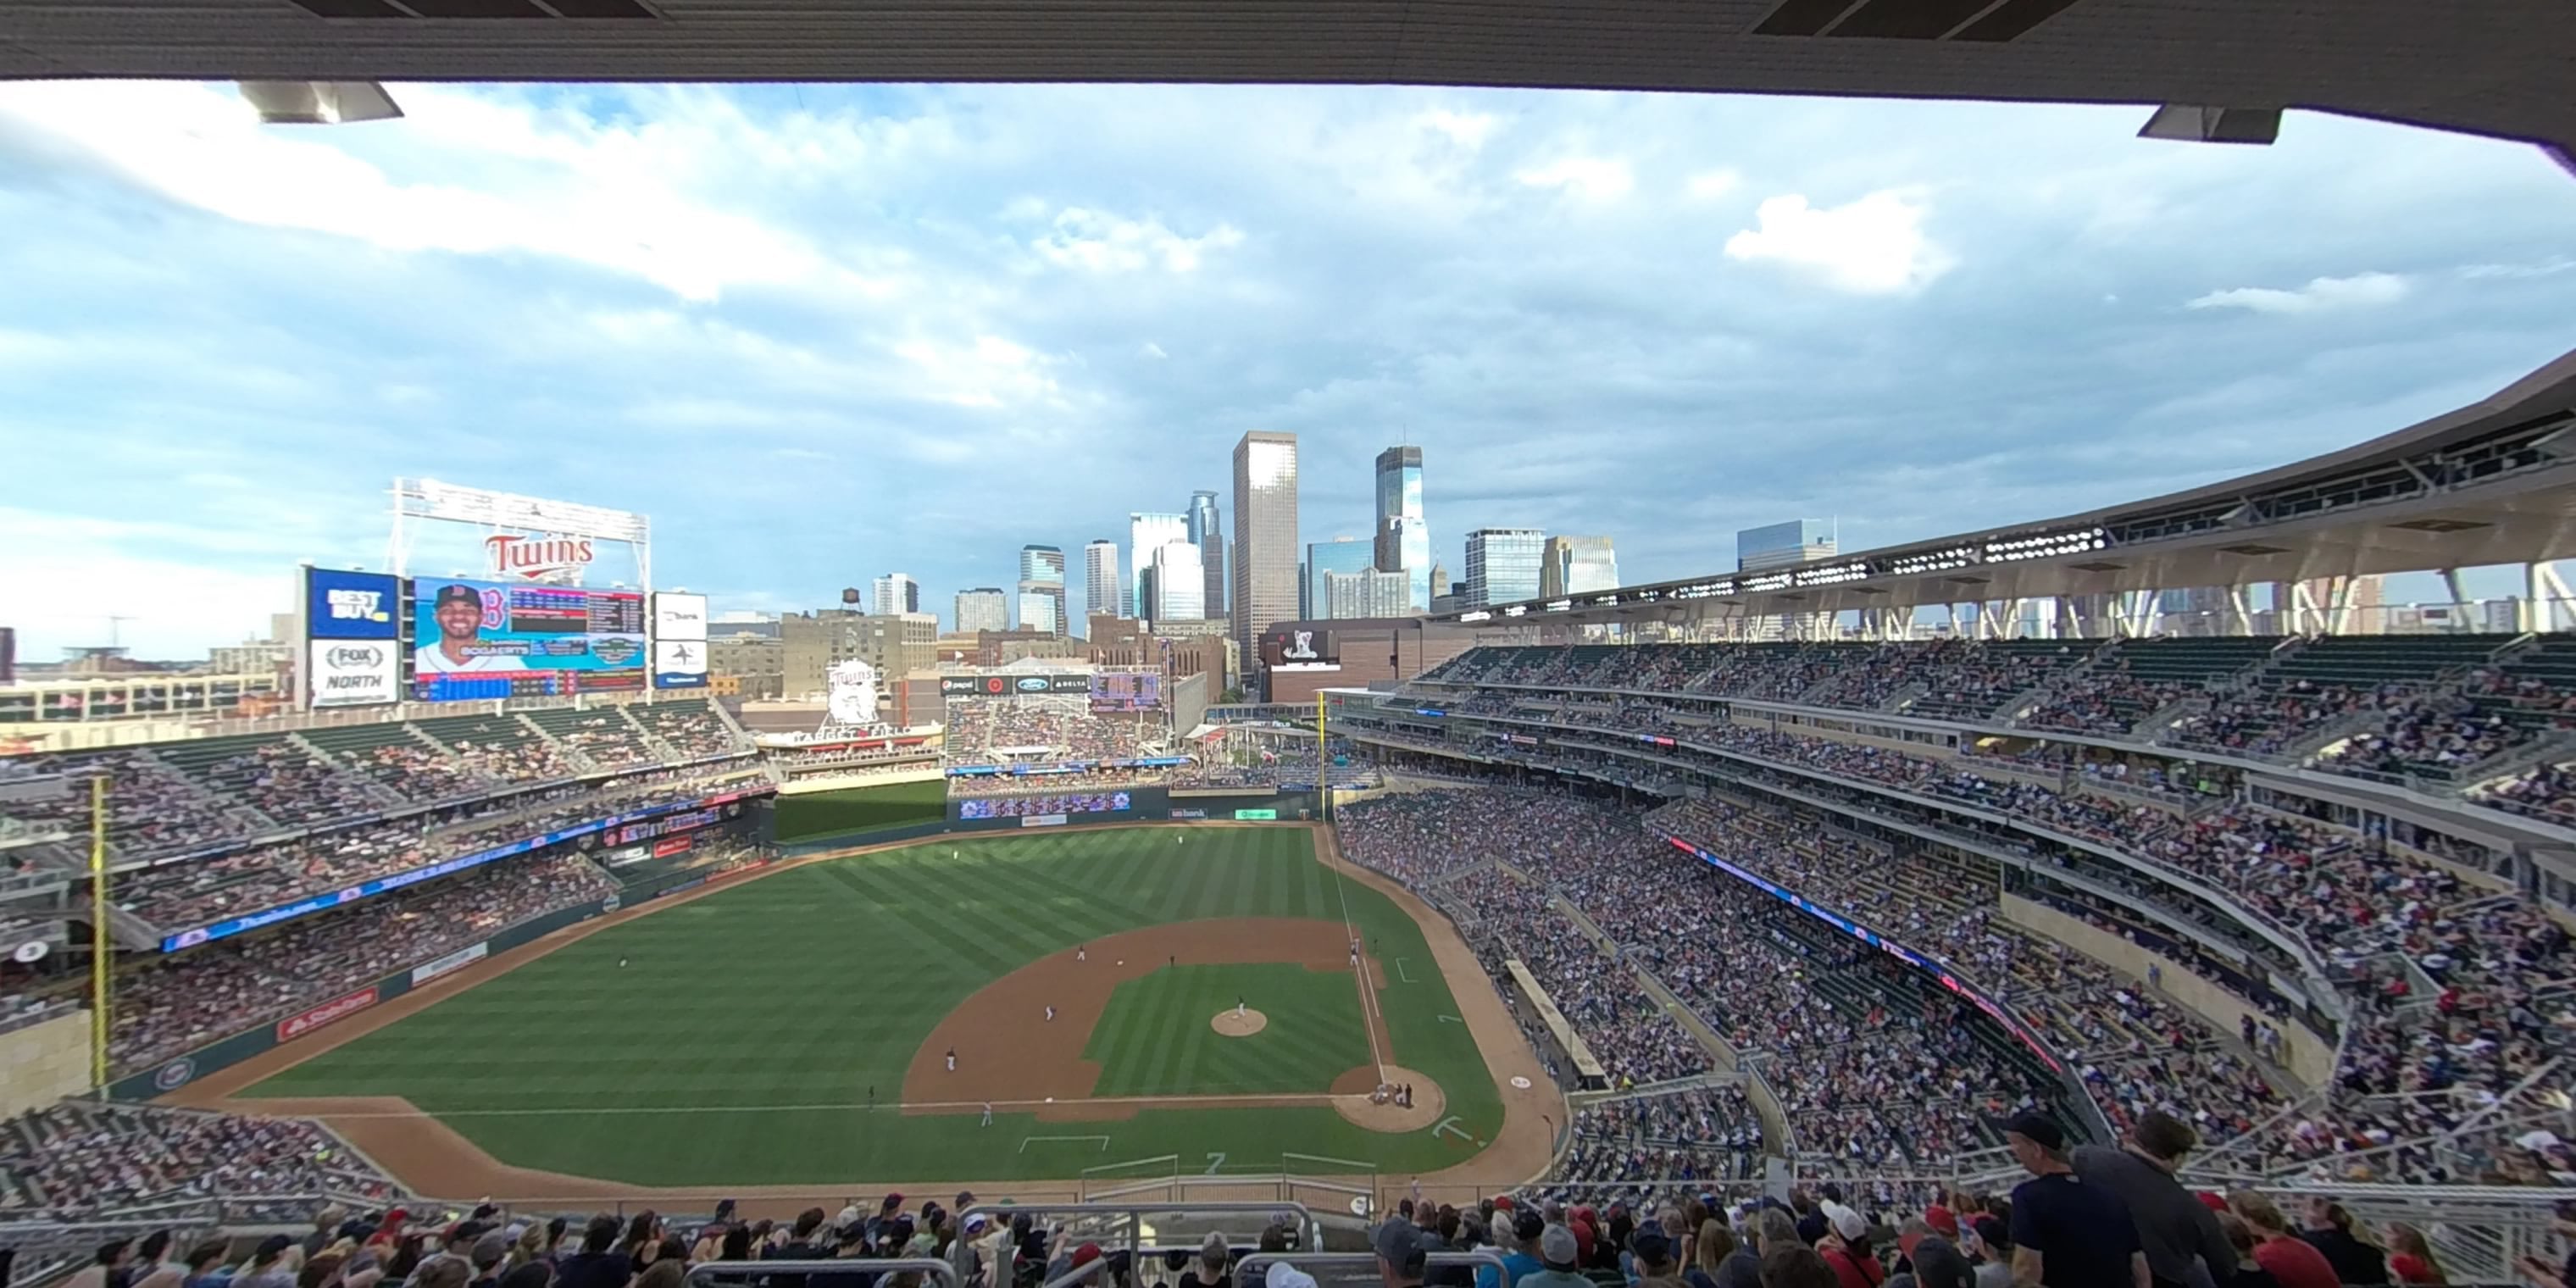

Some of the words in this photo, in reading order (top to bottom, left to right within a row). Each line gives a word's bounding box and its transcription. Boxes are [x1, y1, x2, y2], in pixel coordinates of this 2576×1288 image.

[485, 535, 593, 578] Twins
[327, 589, 382, 606] BEST
[331, 604, 375, 619] BUY
[480, 587, 505, 629] B
[339, 647, 371, 662] FOX
[326, 675, 383, 690] NORTH
[952, 680, 974, 690] pepsi
[793, 727, 856, 742] TARGET
[870, 724, 912, 738] FIELD
